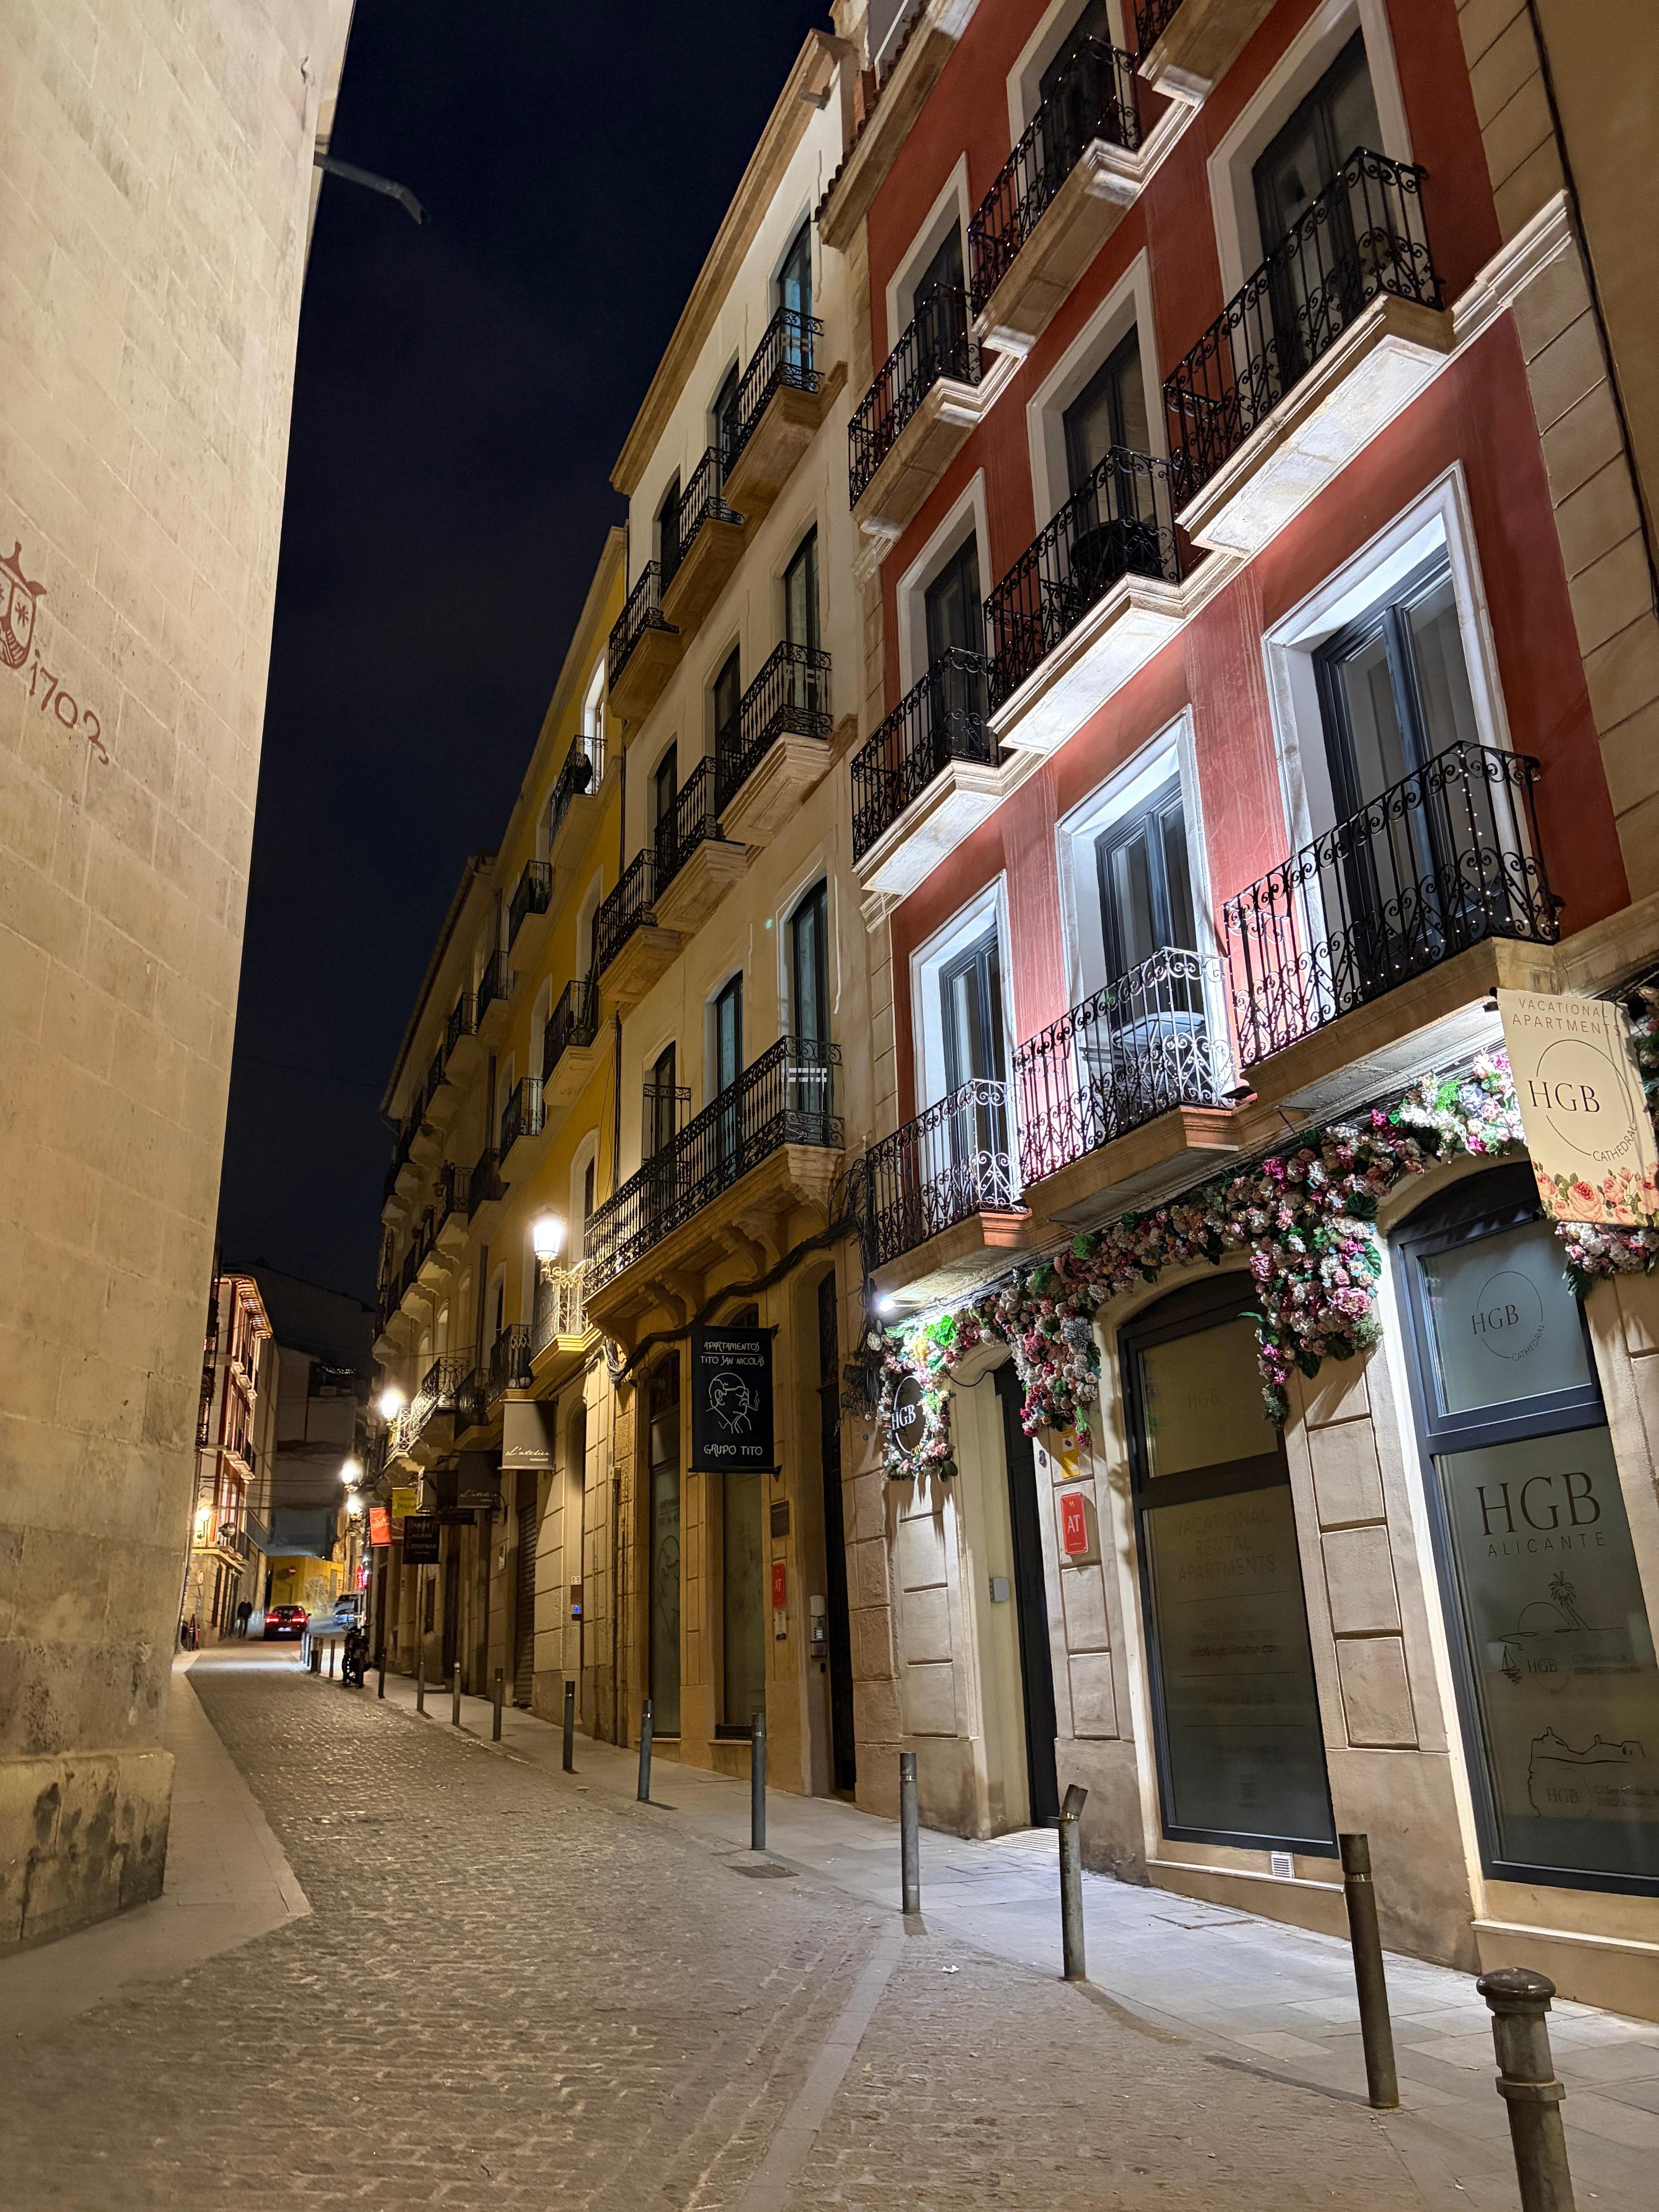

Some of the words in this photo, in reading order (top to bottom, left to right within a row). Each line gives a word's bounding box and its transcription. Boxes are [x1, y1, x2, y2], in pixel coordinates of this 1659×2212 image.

[30, 662, 109, 765] 1702
[1519, 998, 1608, 1018] VACATIONAL
[1513, 1014, 1621, 1036] APARTMENTS
[1527, 1080, 1600, 1113] HGB
[1593, 1125, 1637, 1161] CATHEDRAL
[1472, 1305, 1519, 1334] HGB
[704, 1341, 760, 1352] APARTAMENTOS
[1512, 1325, 1544, 1361] CATHEDRAL
[700, 1356, 719, 1364] TITO
[720, 1355, 733, 1366] SAN
[736, 1356, 764, 1367] NICOLÁS
[891, 1405, 916, 1430] HGB
[505, 1446, 550, 1456] L'atelier
[704, 1444, 737, 1457] GRUPO
[740, 1446, 763, 1456] TITO
[1475, 1472, 1600, 1536] HGB
[1068, 1514, 1080, 1534] AT
[1174, 1508, 1270, 1536] VACATIONAL
[1195, 1535, 1252, 1556] RENTAL
[1488, 1532, 1605, 1558] ALICANTE
[1179, 1553, 1276, 1582] APARTMENTS
[1528, 1658, 1558, 1673] HGB
[1547, 1788, 1580, 1803] HGB
